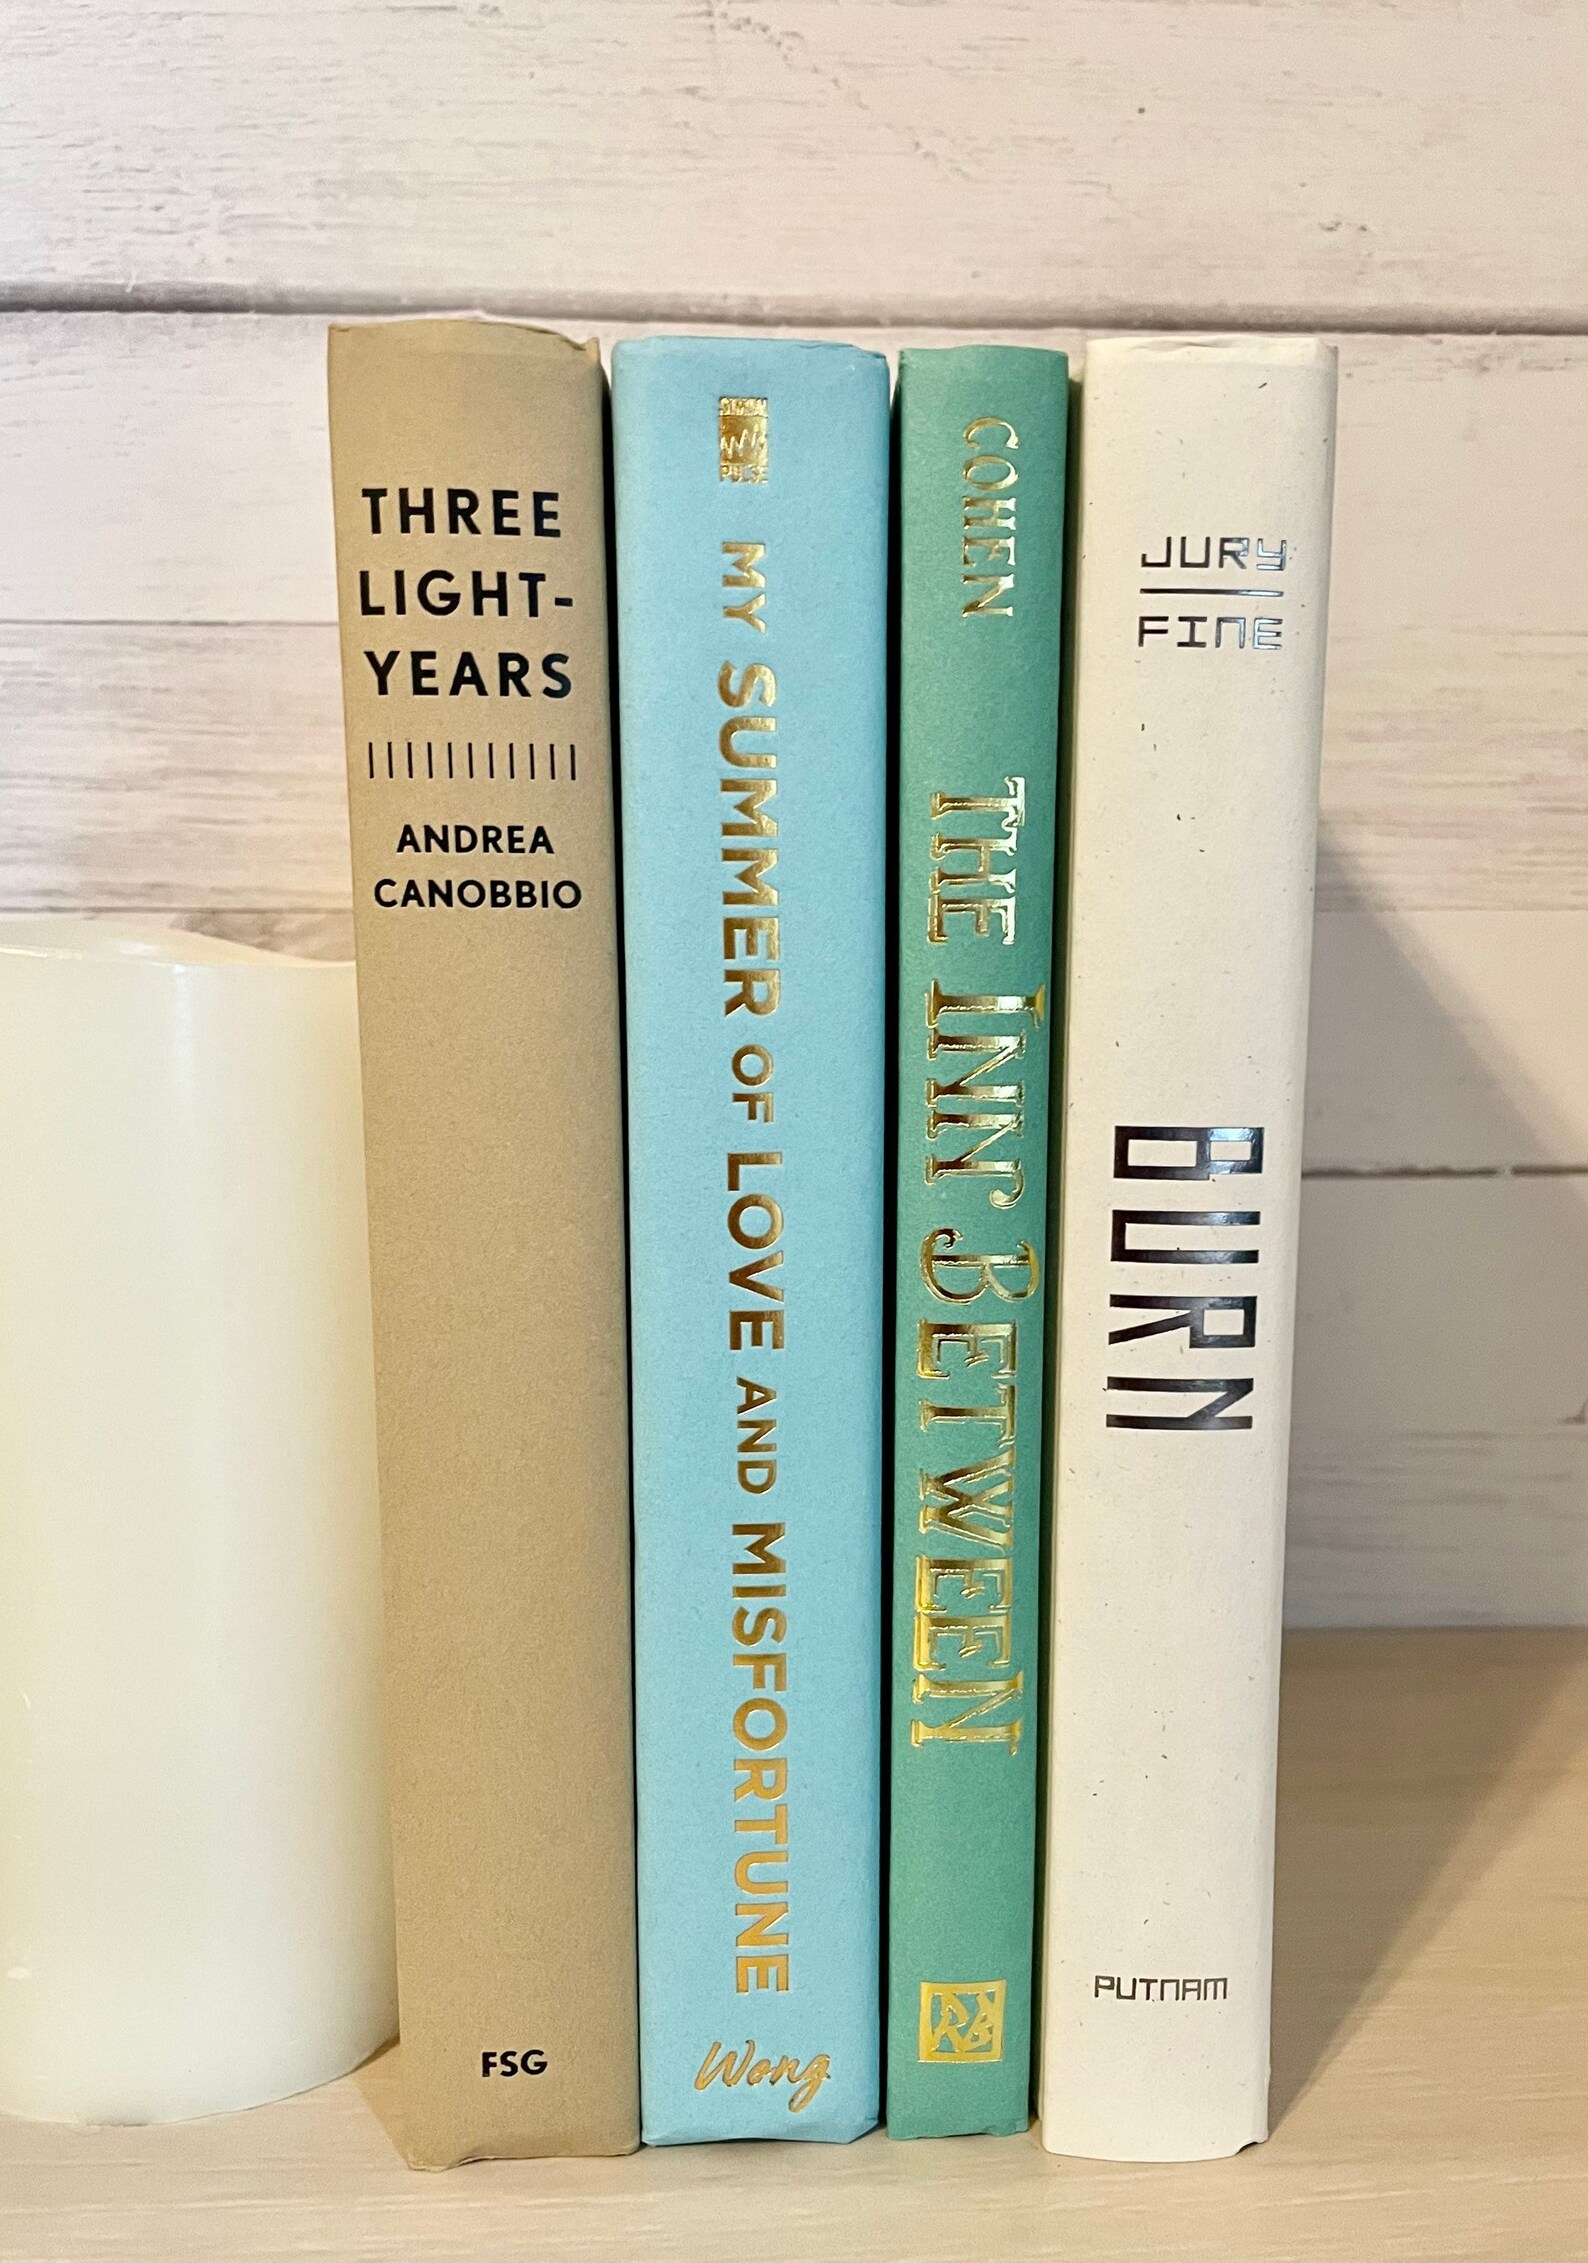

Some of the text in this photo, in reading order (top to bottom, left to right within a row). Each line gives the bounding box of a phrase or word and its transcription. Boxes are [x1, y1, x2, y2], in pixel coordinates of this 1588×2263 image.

[361, 487, 561, 538] THREE
[962, 416, 1019, 618] COHEN
[1140, 536, 1287, 571] JURY
[359, 569, 574, 618] LIGHT-
[1138, 616, 1284, 650] FINE
[363, 650, 573, 699] YEARS
[396, 824, 555, 855] ANDREA
[373, 878, 582, 910] CANOBBIO
[717, 541, 790, 1994] MY SUMMER OF LOVE AND MISFORTUNE
[910, 775, 1046, 1757] THE INN BETWEEN
[1106, 1126, 1264, 1431] BURN
[1094, 1975, 1228, 2002] PUTNAM
[482, 2049, 548, 2078] FSG
[694, 2039, 831, 2113] Wong
